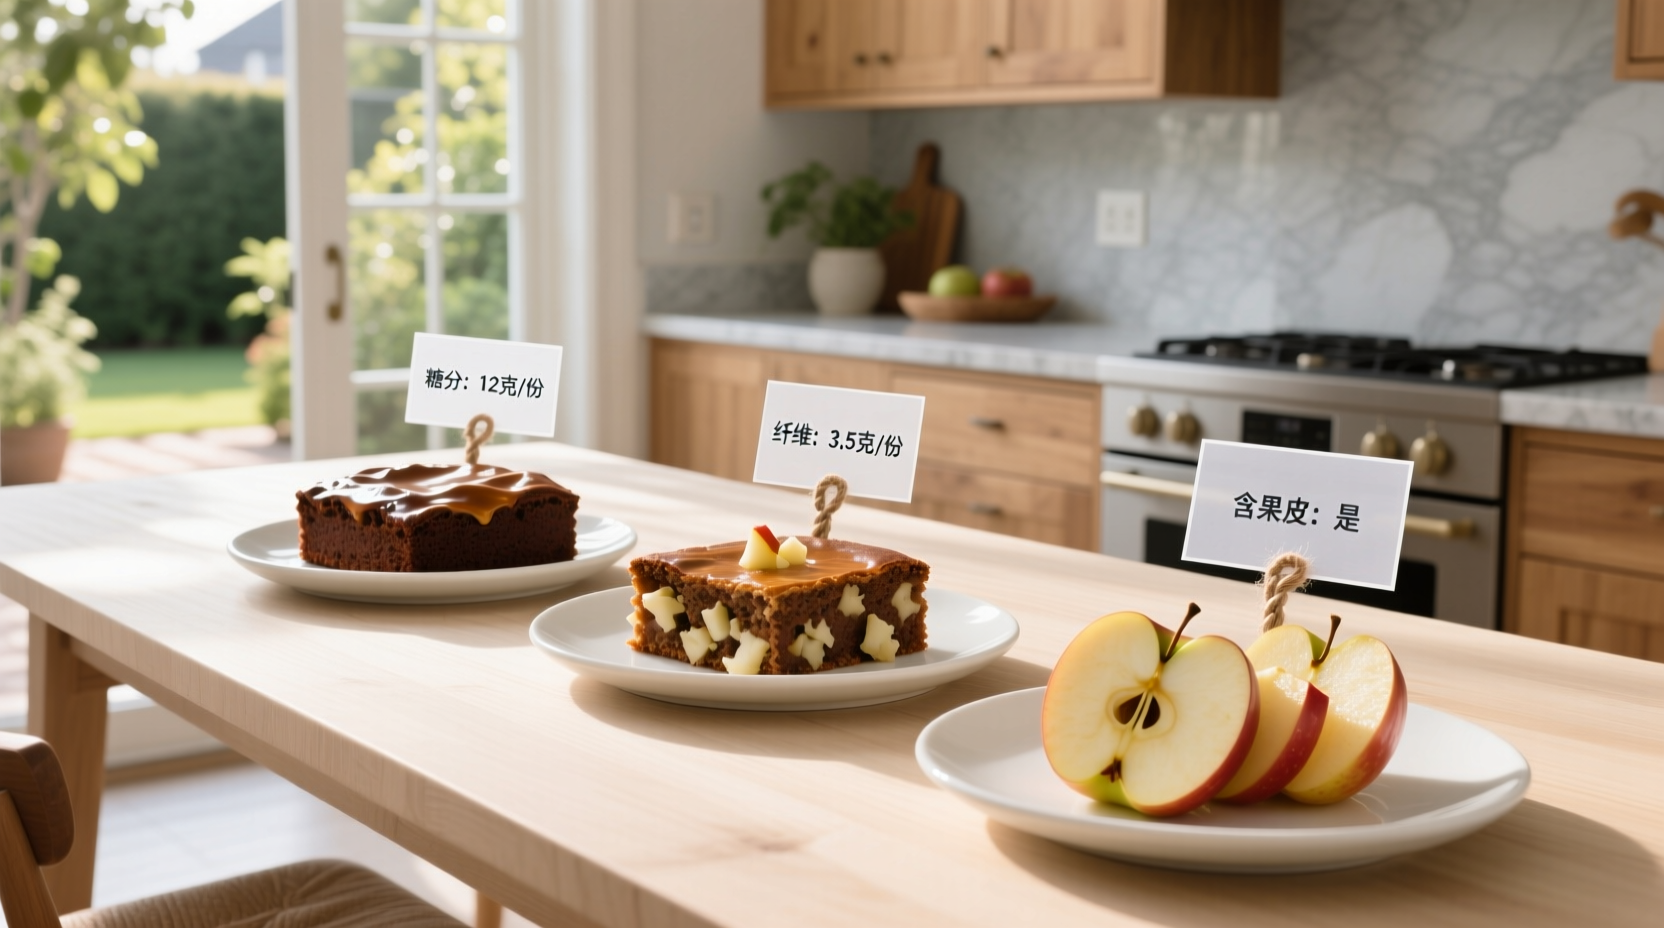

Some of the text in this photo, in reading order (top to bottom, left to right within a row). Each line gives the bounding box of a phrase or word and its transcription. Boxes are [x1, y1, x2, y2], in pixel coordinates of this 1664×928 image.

[424, 368, 545, 399] 糖分：12克/份
[771, 420, 904, 458] 纤维：3.5克/份
[1233, 491, 1360, 533] 含果皮：是
